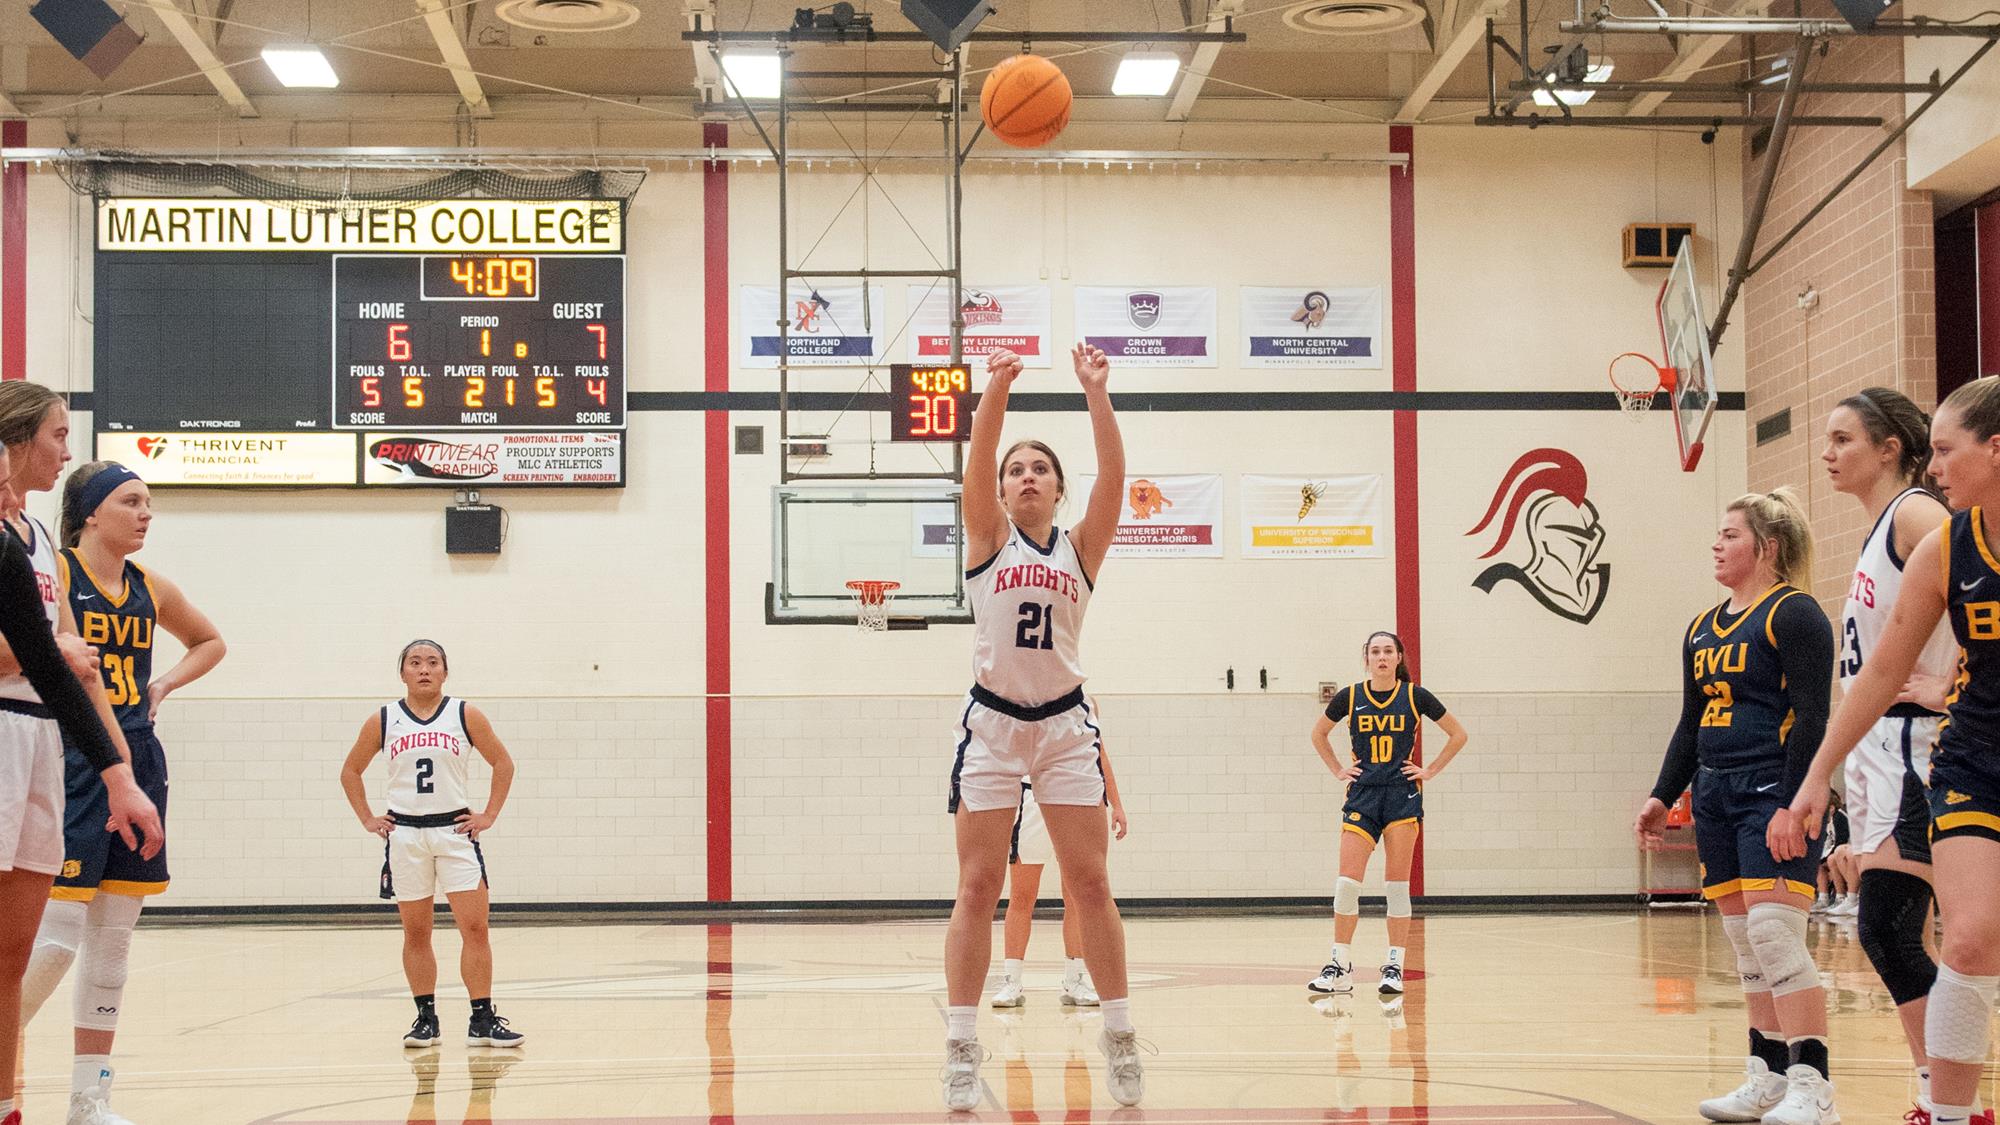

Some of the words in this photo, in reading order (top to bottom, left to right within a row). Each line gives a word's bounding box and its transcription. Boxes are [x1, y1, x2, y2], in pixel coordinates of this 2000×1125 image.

[108, 208, 251, 243] MARTIN
[268, 208, 416, 244] LUTHER
[431, 208, 610, 244] COLLEGE
[451, 259, 533, 296] 4:09
[359, 303, 404, 318] HOME
[553, 303, 604, 319] GUEST
[460, 316, 499, 328] PERIOD
[388, 324, 411, 360] 6
[480, 328, 491, 357] 1
[584, 325, 606, 360] 7
[931, 338, 974, 346] BETNY
[977, 338, 1026, 346] LUTHERAN
[1127, 338, 1162, 346] CROWN
[1272, 339, 1304, 347] NORTH
[1306, 339, 1349, 347] CENTRAL
[963, 346, 999, 354] OLLEG
[1123, 347, 1167, 355] COLLEGE
[1283, 347, 1338, 355] UNIVERSITY
[350, 365, 385, 377] FOULS
[399, 365, 431, 377] T.O.L.
[444, 365, 486, 377] PLAYER
[492, 365, 519, 377] FOUL
[533, 365, 564, 377] T.O.L.
[575, 365, 609, 377] FOULS
[911, 369, 966, 393] 4:09
[361, 378, 381, 407] 5
[403, 377, 425, 408] 5
[464, 377, 486, 408] 2
[505, 377, 516, 407] 1
[534, 377, 557, 408] 5
[586, 378, 606, 407] 4
[350, 412, 386, 424] SCORE
[460, 412, 498, 424] MATCH
[576, 412, 611, 424] SCORE
[910, 395, 956, 434] 30
[180, 420, 241, 428] DAKTRONICS
[179, 439, 288, 451] THRIVENT
[503, 435, 559, 443] PROMOTIONAL
[561, 434, 584, 443] ITEMS
[376, 443, 499, 462] PRINTWEAR
[506, 447, 557, 457] PROUDLY
[559, 447, 615, 457] SUPPORTS
[183, 456, 259, 464] FINANCIAL
[518, 459, 541, 469] MLC
[544, 459, 603, 469] ATHLETICS
[431, 463, 499, 474] GRAPHICS
[503, 473, 529, 481] SCREEN
[531, 473, 564, 481] PRINTING
[573, 473, 617, 481] EMBROIDERY
[1116, 527, 1170, 535] UNIVERSITY
[1173, 527, 1185, 535] OF
[1112, 535, 1198, 543] INNESOTA-MORRIS
[994, 563, 1079, 604] KNIGHTS
[83, 611, 152, 649] BVU
[1016, 601, 1054, 650] 21
[1840, 616, 1863, 678] 3
[1694, 642, 1749, 681] BVU
[104, 653, 141, 706] 31
[1358, 714, 1405, 732] BVU
[390, 731, 460, 760] KNIGHTS
[1370, 735, 1393, 764] 10
[416, 758, 434, 794] 2
